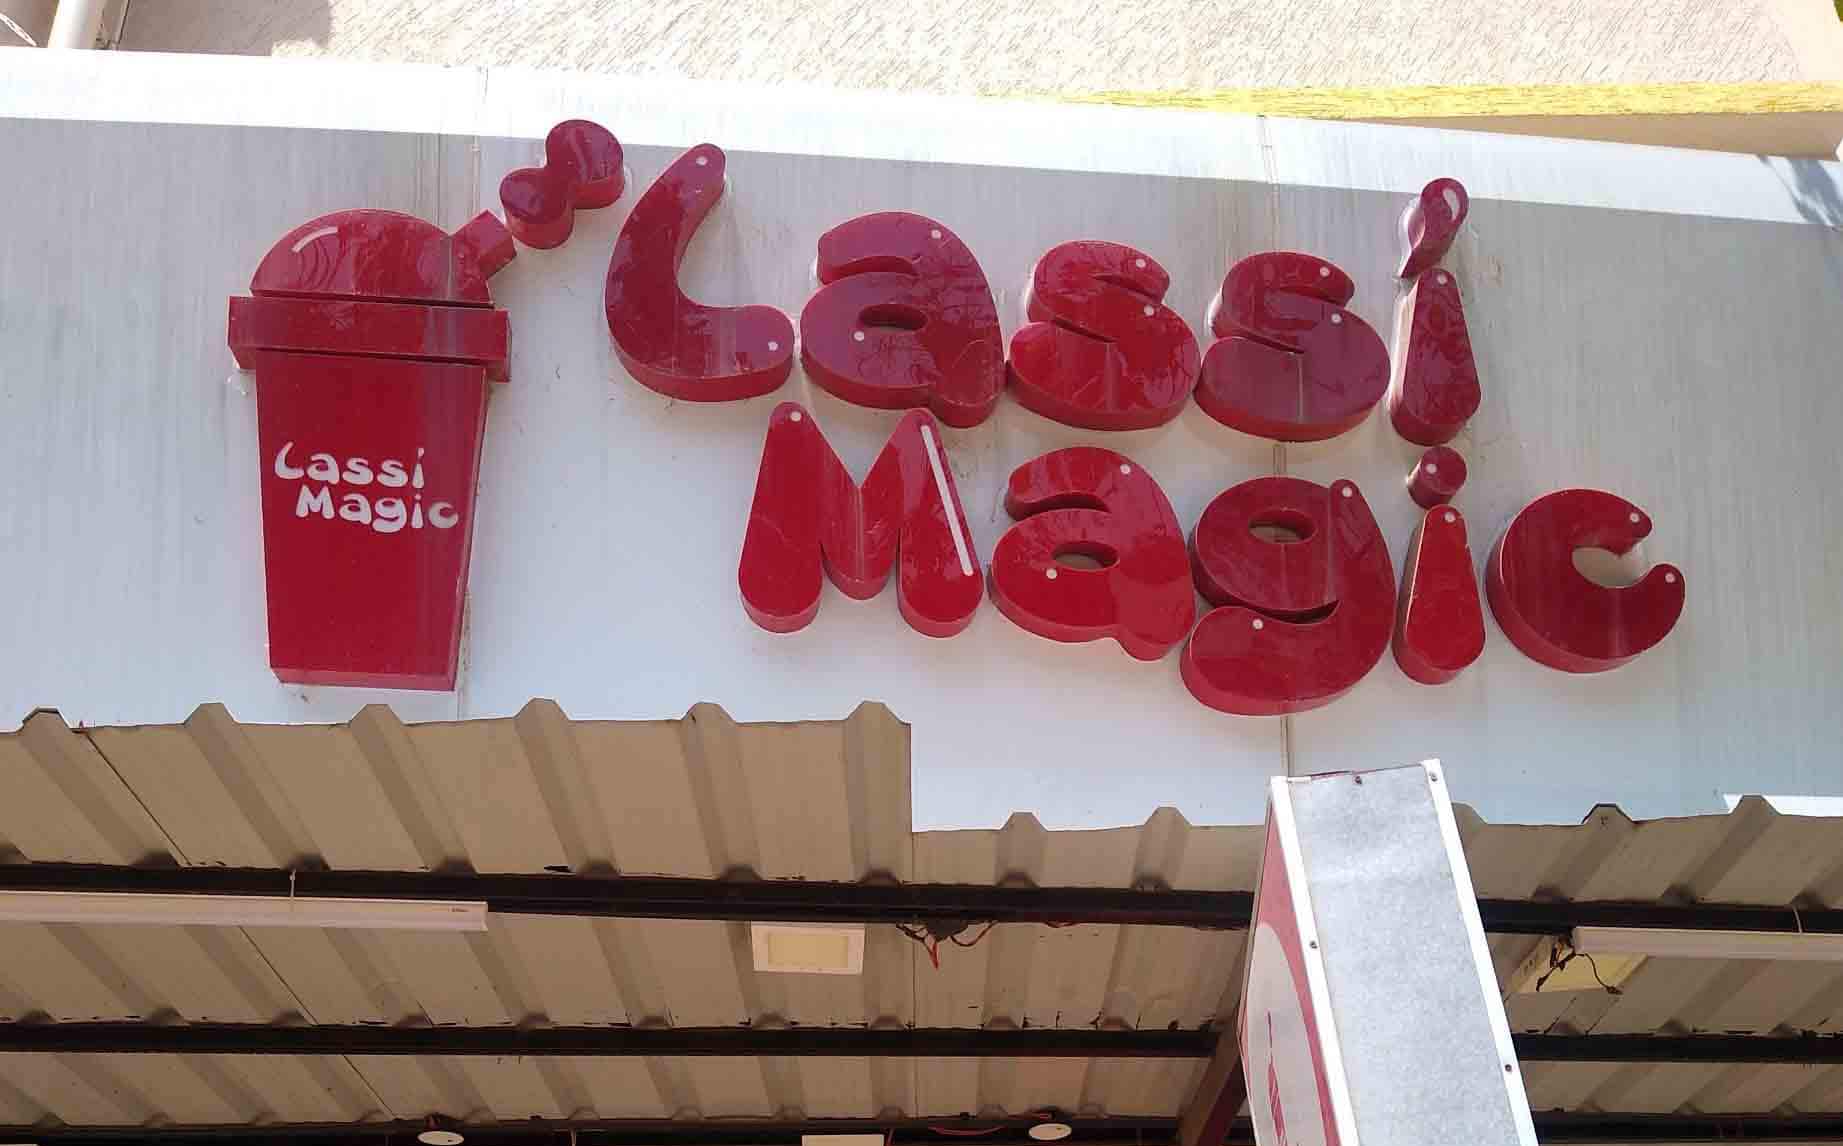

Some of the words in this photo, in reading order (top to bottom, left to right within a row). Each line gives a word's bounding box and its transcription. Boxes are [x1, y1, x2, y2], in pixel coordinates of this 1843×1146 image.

[605, 142, 1481, 447] Lassi
[274, 441, 425, 488] Lassi
[295, 487, 459, 533] Magic
[738, 402, 1686, 716] Magic
